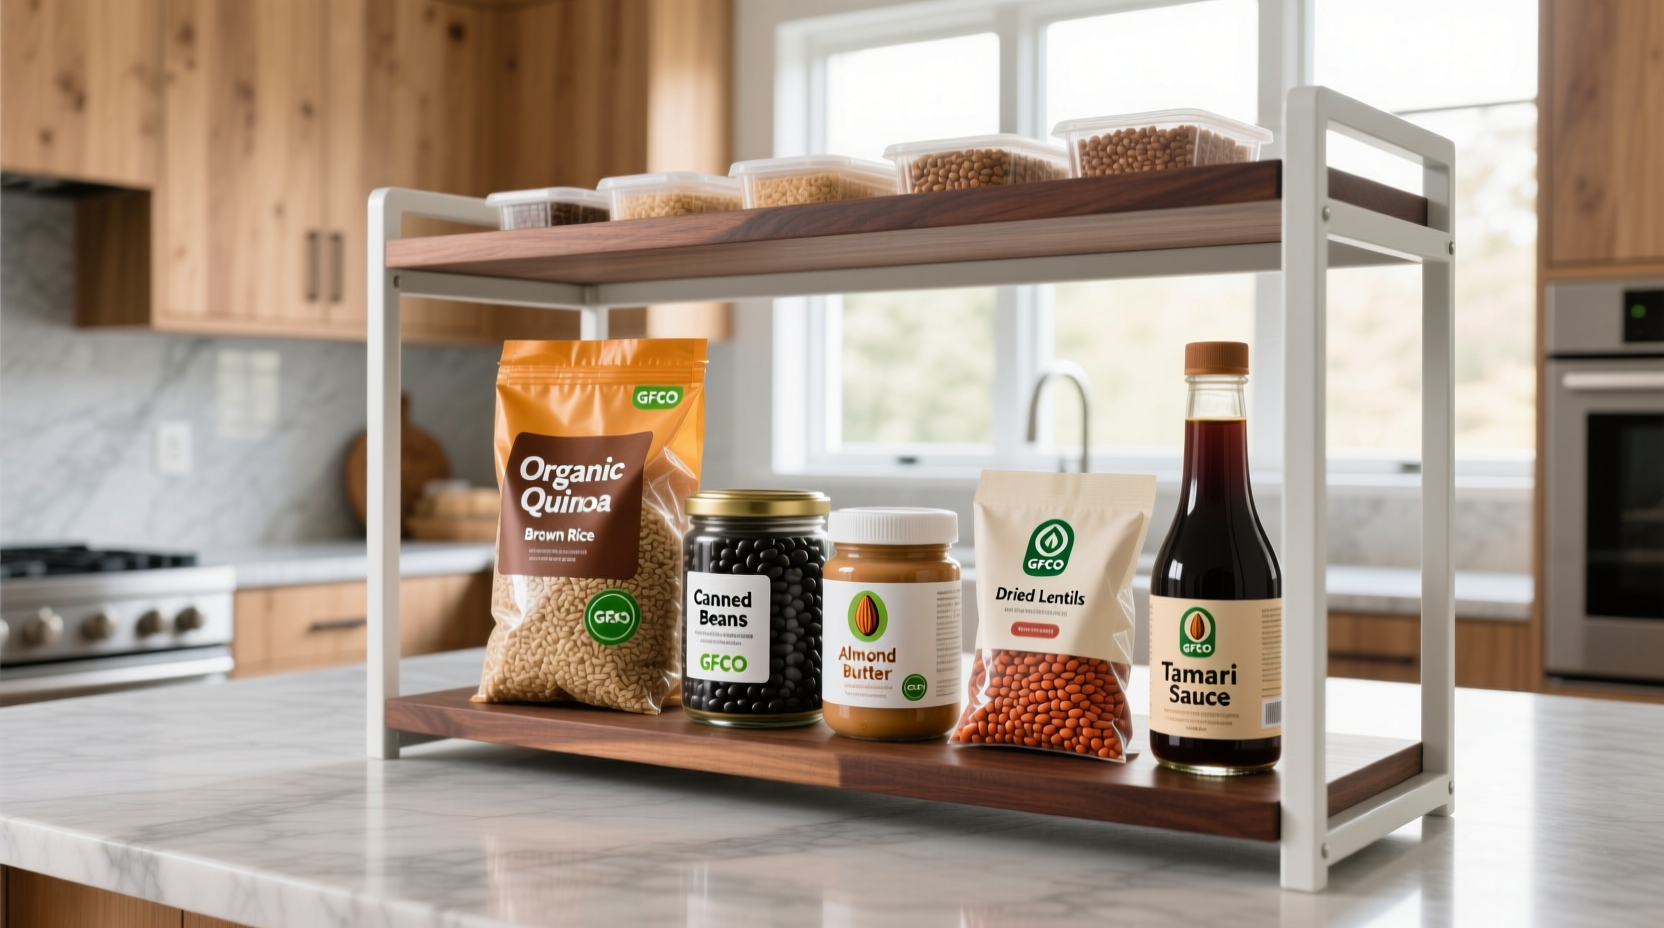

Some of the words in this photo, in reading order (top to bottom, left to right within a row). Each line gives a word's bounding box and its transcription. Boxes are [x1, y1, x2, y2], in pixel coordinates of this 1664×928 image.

[637, 390, 679, 405] GFCO
[520, 456, 625, 490] Organic
[521, 487, 612, 518] Quinoa
[524, 528, 564, 541] Brown
[567, 528, 595, 542] Rice
[1028, 558, 1064, 570] GFCO
[694, 589, 752, 608] Canned
[996, 587, 1036, 602] Dried
[1039, 589, 1086, 605] Lentils
[700, 610, 748, 627] Beans
[700, 653, 748, 672] GFCO
[838, 646, 896, 663] Almond
[843, 664, 893, 680] Butter
[1162, 661, 1237, 685] Tamari
[1169, 684, 1231, 706] Sauce
